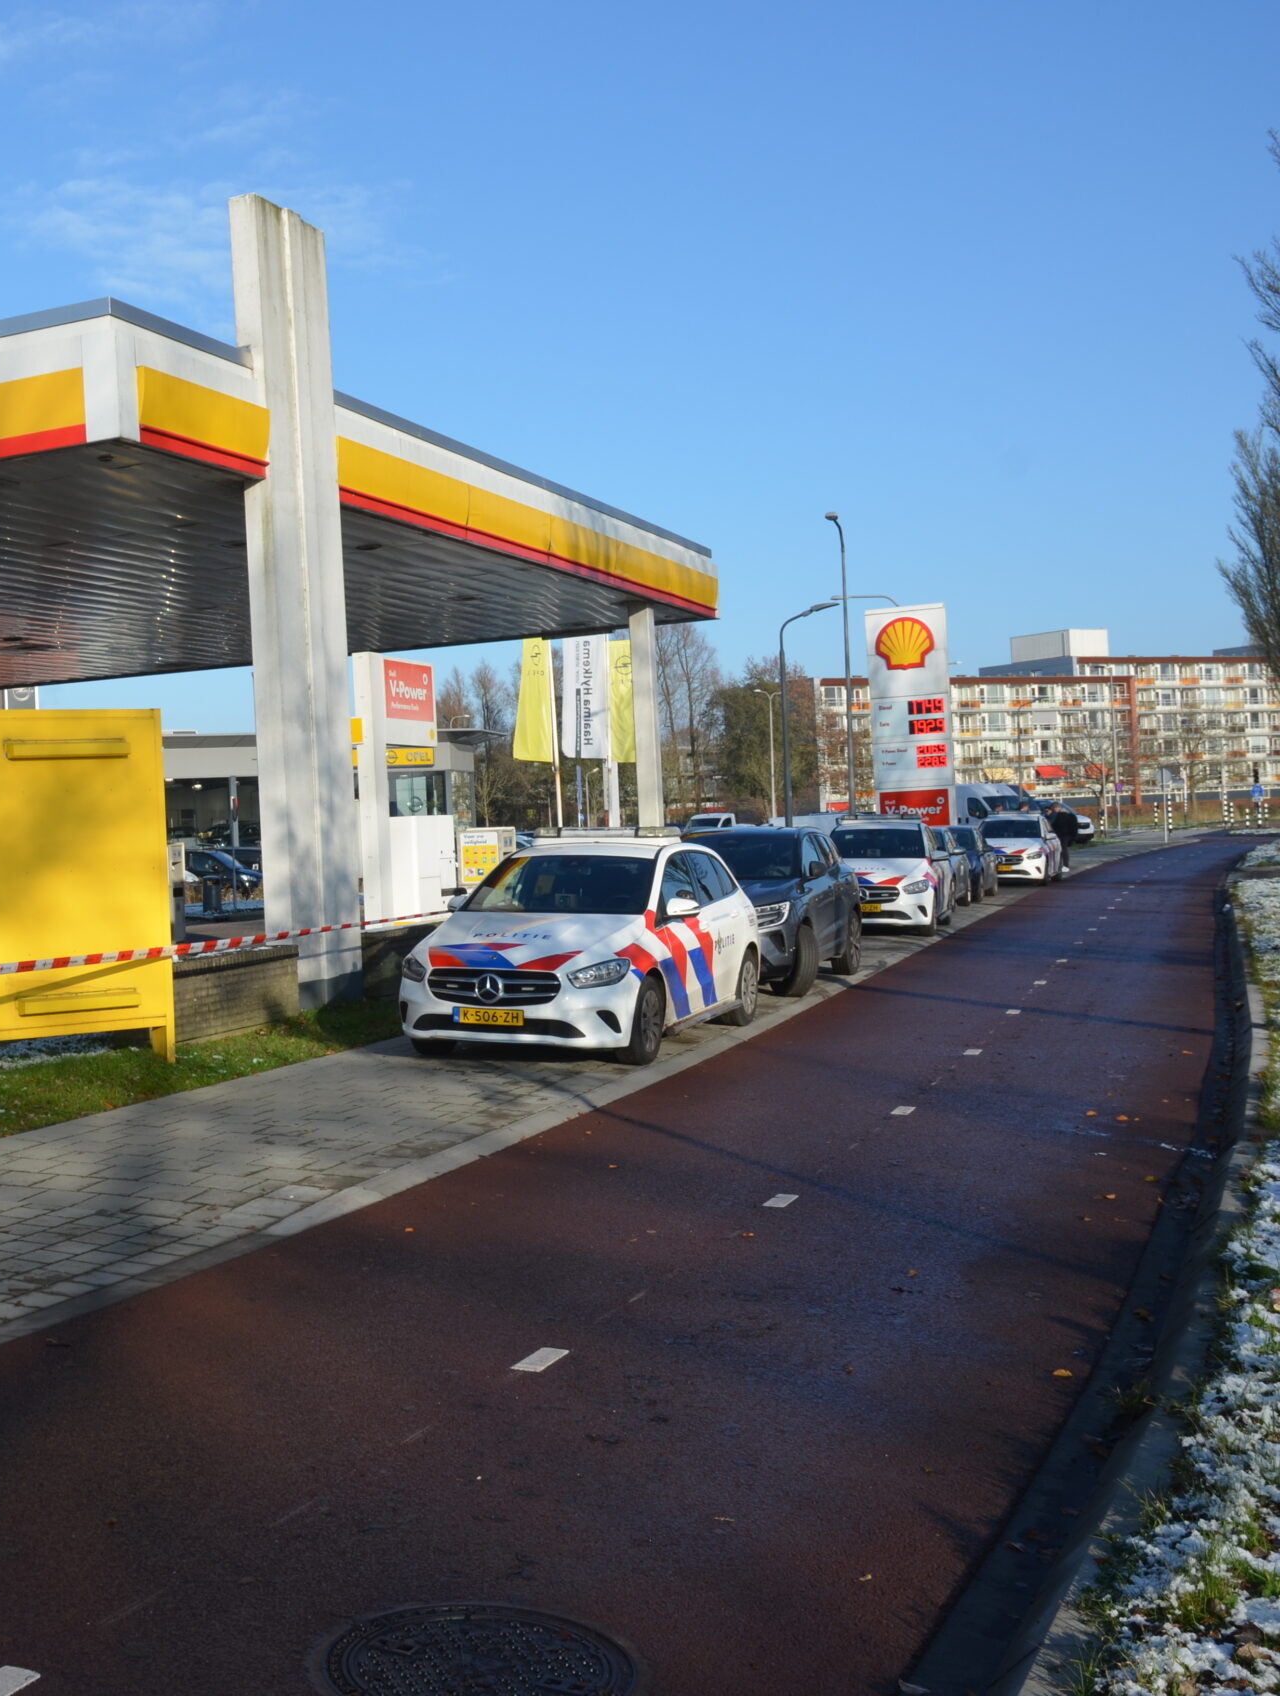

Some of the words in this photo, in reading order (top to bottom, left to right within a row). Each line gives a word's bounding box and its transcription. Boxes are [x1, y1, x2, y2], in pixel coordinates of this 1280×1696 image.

[389, 679, 427, 701] V-Power
[912, 698, 945, 715] 1749
[913, 718, 946, 735] 1929
[406, 752, 431, 762] OPEL
[885, 805, 943, 815] V-Power
[473, 932, 552, 940] POLITIE
[462, 1010, 519, 1024] K-506-ZH
